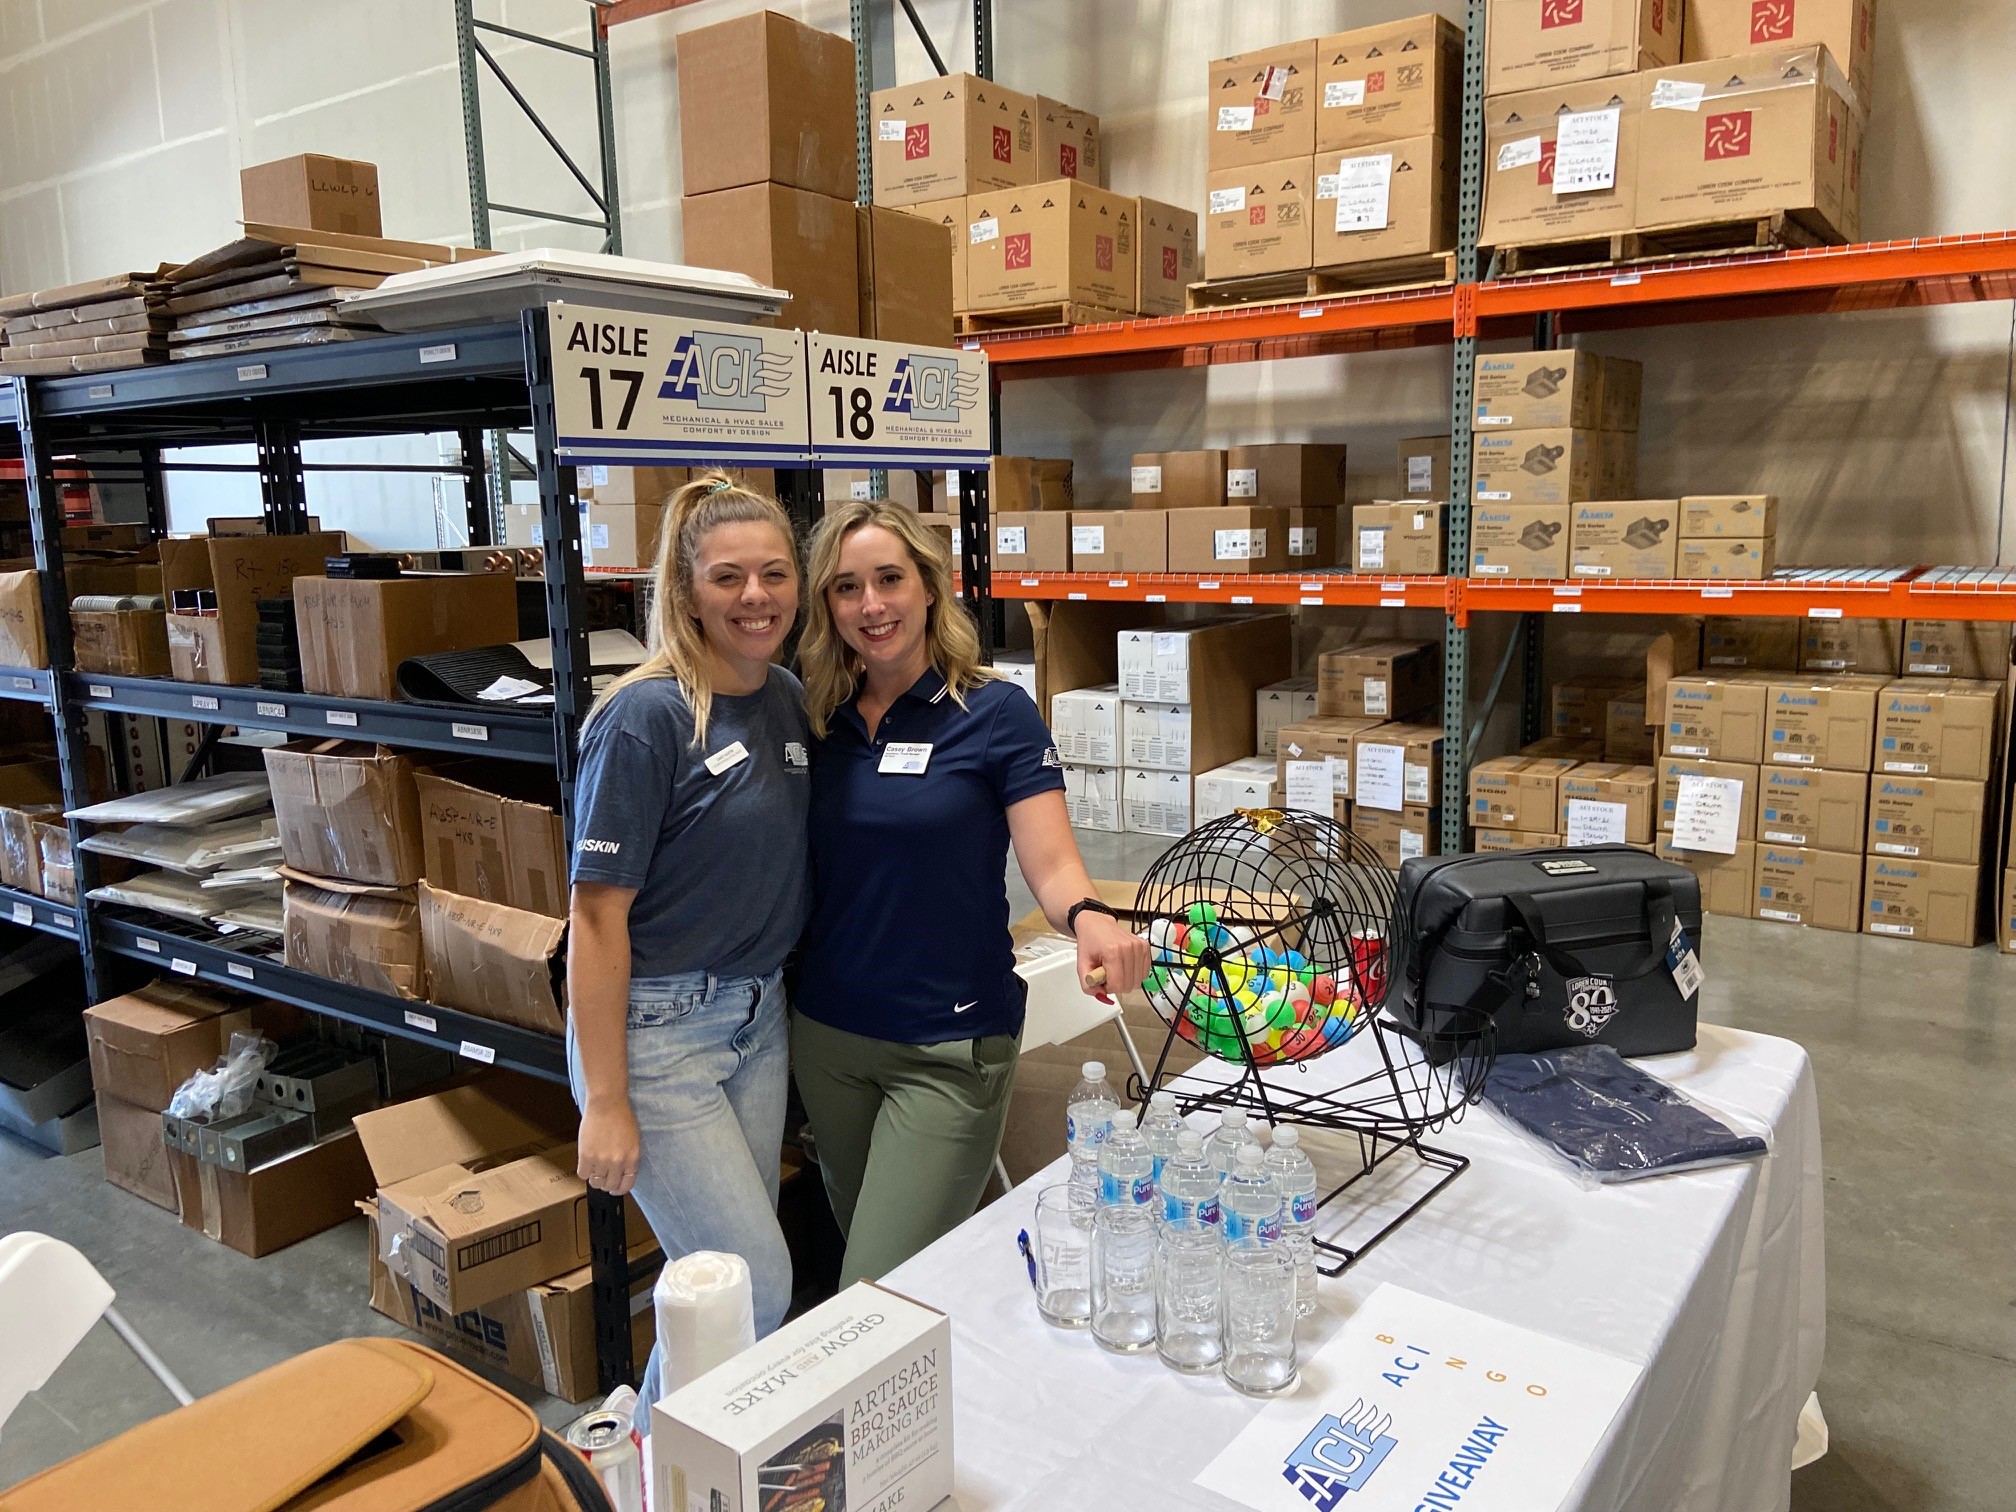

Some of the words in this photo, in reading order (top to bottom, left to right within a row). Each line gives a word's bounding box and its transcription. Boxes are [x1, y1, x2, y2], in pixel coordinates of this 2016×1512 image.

[566, 321, 648, 358] AISLE
[674, 344, 752, 398] ACI
[820, 348, 878, 378] AISLE
[579, 366, 645, 431] 17
[894, 365, 949, 411] ACI
[662, 415, 721, 424] MECHANICAL
[828, 386, 875, 441] 18
[683, 427, 726, 435] COMFORT
[1792, 698, 1818, 706] DELTA
[1894, 788, 1924, 796] DELTA
[1579, 804, 1592, 812] ACI
[1778, 856, 1804, 865] DELTA
[1890, 868, 1918, 878] DELTA
[1569, 986, 1612, 1029] 80
[1198, 1206, 1216, 1218] Pure
[1293, 1201, 1312, 1212] Pure
[1258, 1223, 1276, 1234] Pure
[432, 1268, 448, 1288] 209
[821, 1313, 884, 1356] GROW
[822, 1315, 854, 1338] crafting
[767, 1354, 791, 1371] every
[796, 1354, 820, 1370] AND
[1382, 1344, 1430, 1388] ACI
[723, 1368, 799, 1416] MAKE
[725, 1370, 766, 1396] occasion
[851, 1348, 937, 1425] ARTISAN
[851, 1412, 884, 1447] BBQ
[888, 1373, 938, 1420] SAUCE
[852, 1411, 912, 1466] MAKING
[915, 1393, 939, 1421] KIT
[880, 1441, 903, 1460] complete
[918, 1416, 938, 1434] making
[1296, 1425, 1374, 1502] ACI
[1414, 1415, 1509, 1512] GIVEAWAY
